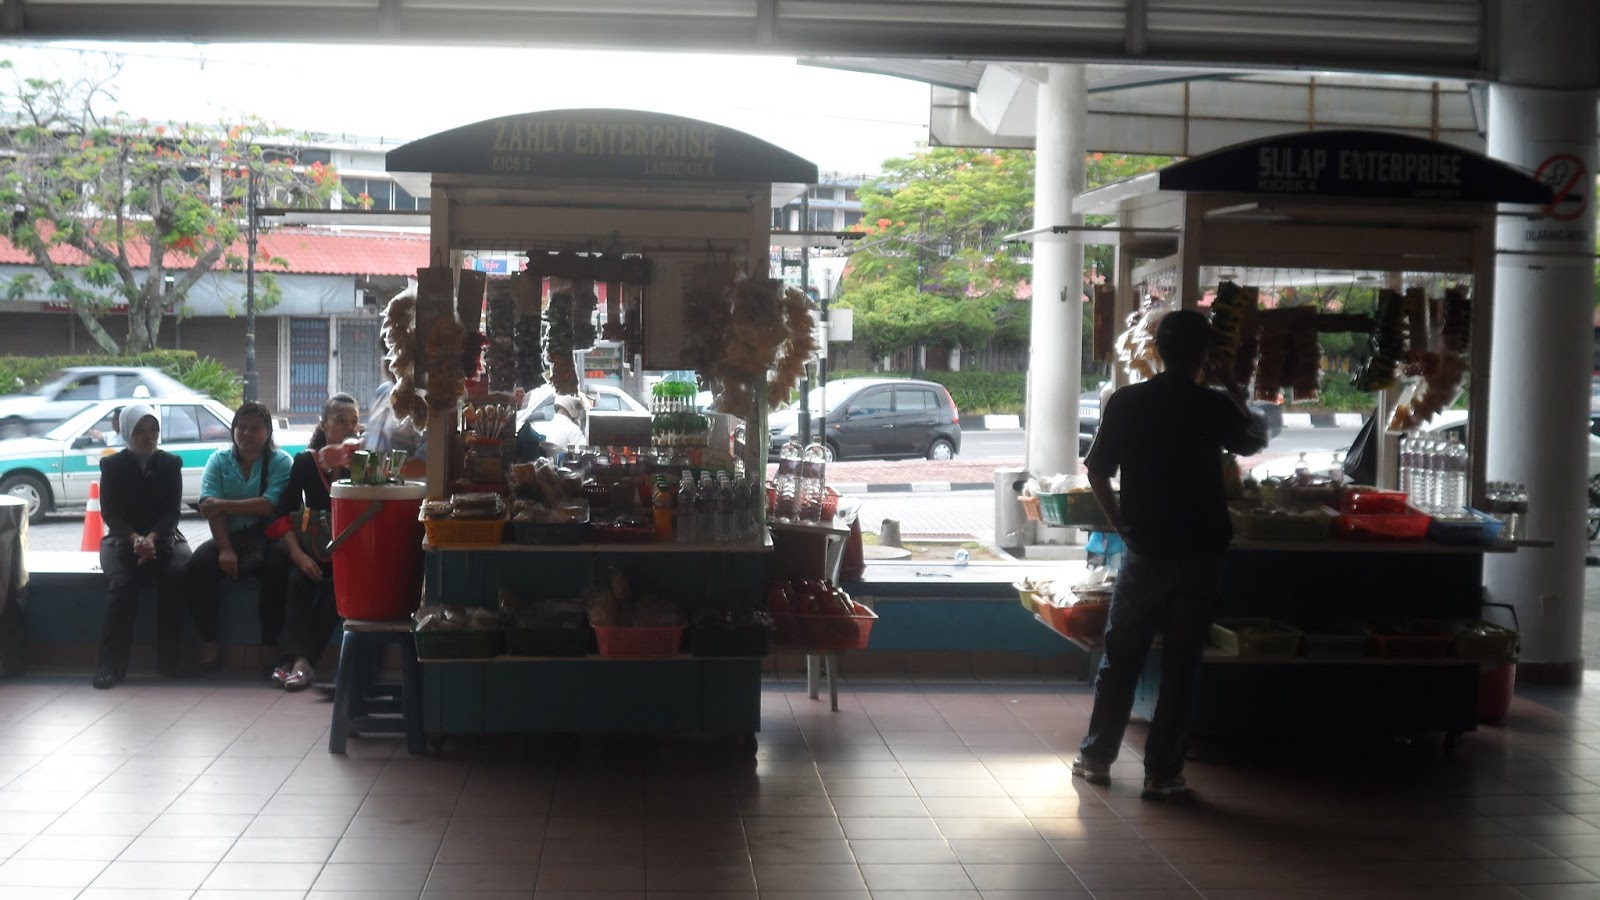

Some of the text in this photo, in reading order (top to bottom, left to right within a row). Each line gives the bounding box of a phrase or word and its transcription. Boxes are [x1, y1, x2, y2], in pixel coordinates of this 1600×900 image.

[493, 119, 716, 158] ZAHLY ENTERPRISE
[1258, 147, 1462, 185] SULAP ENTERPRISE
[1258, 178, 1304, 192] KIOSK
